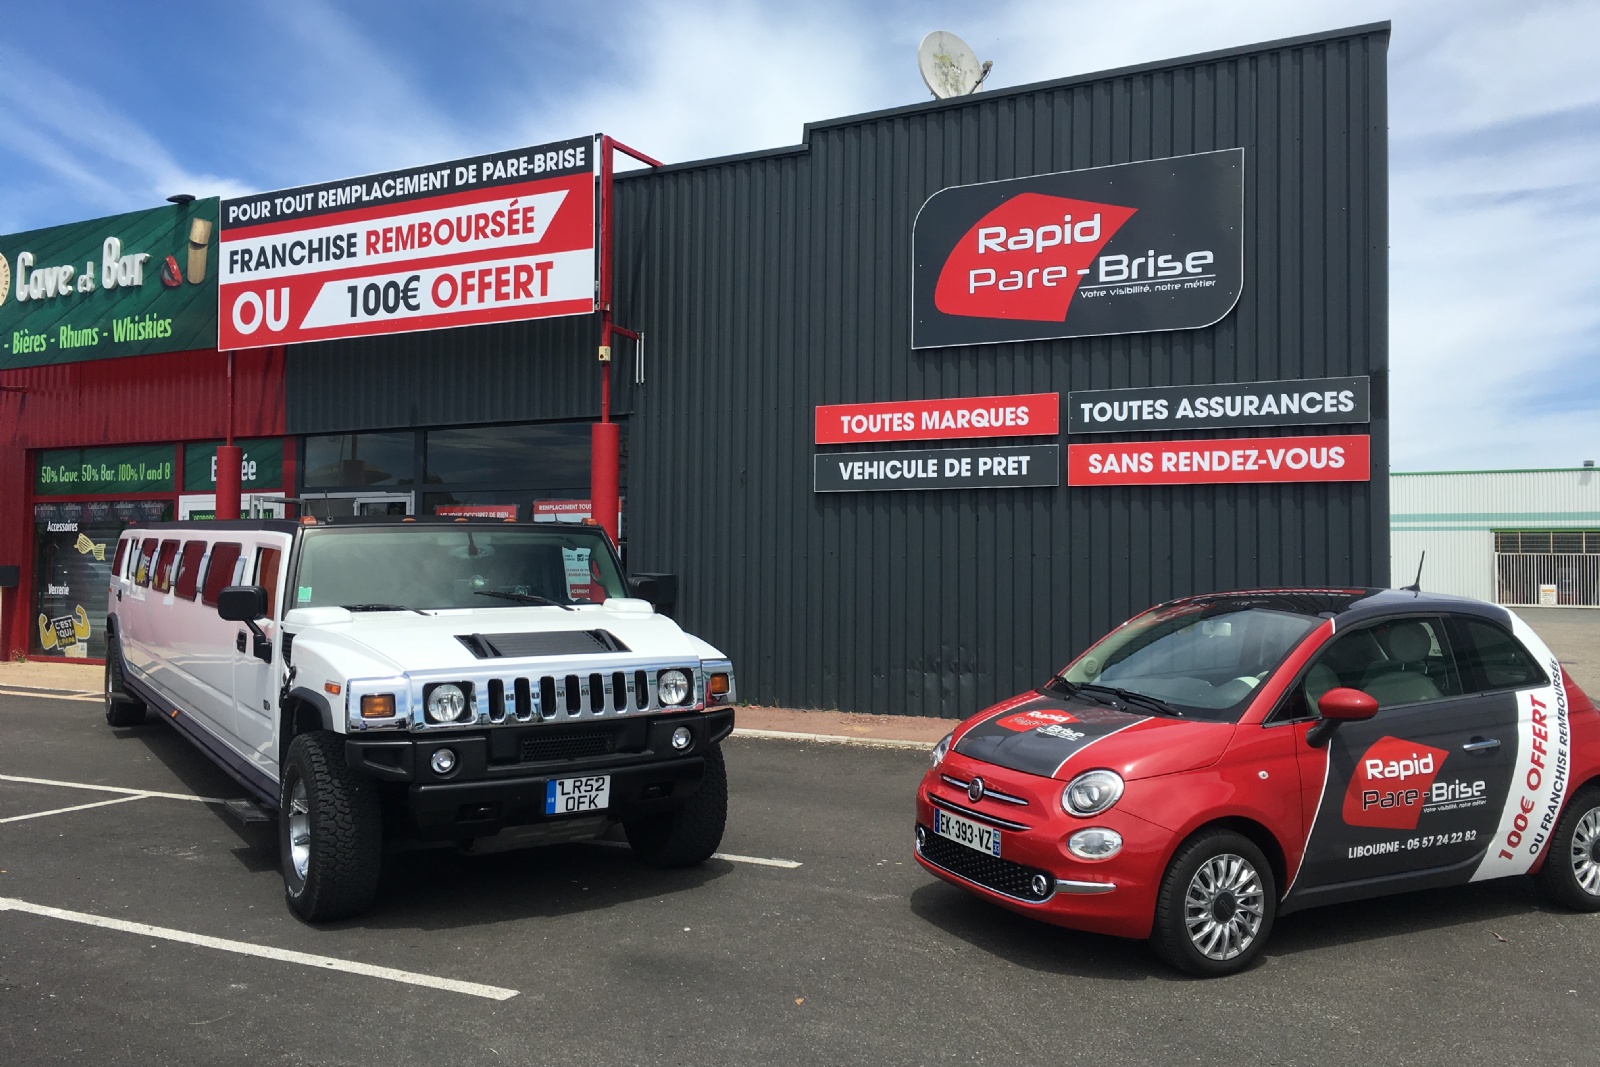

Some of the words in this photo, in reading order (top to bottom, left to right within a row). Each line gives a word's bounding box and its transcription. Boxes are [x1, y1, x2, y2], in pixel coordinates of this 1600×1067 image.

[229, 205, 271, 223] POUR
[275, 194, 313, 216] TOUT
[318, 170, 451, 208] REMPLACEMENT
[455, 163, 477, 186] DE
[482, 146, 585, 182] PARE-BRISE
[229, 233, 357, 274] FRANCHISE
[365, 199, 535, 256] REMBOURSÉE
[978, 213, 1101, 254] Rapid
[16, 251, 75, 303] Cave
[102, 236, 151, 290] Bar
[232, 287, 290, 335] OU
[347, 275, 421, 318] 100€
[431, 261, 554, 308] OFFERT
[1081, 290, 1107, 299] Votre
[1155, 281, 1181, 291] notre
[1184, 279, 1216, 290] métier
[12, 328, 47, 354] Bières
[59, 325, 99, 349] Rhums
[113, 312, 172, 343] Whiskies
[841, 413, 915, 433] TOUTES
[921, 406, 1030, 430] MARQUES
[1080, 399, 1169, 423] TOUTES
[1175, 391, 1355, 419] ASSURANCES
[41, 466, 58, 483] 50%
[81, 464, 99, 482] 50%
[118, 463, 138, 482] 100%
[139, 463, 145, 481] V
[147, 463, 163, 480] and
[211, 453, 257, 481] Eée
[839, 458, 938, 480] VEHICULE
[944, 458, 973, 477] DE
[978, 456, 1031, 476] PRET
[1088, 452, 1154, 474] SANS
[1161, 446, 1346, 472] RENDEZ-VOUS
[47, 521, 78, 532] Accessoires
[48, 581, 69, 595] Verrerie
[1550, 657, 1568, 747] REMBOURSÉE
[1365, 752, 1434, 781] Rapid
[1498, 795, 1535, 861] 100€
[1526, 694, 1548, 792] OFFERT
[558, 777, 605, 795] LR52
[1541, 747, 1567, 832] FRANCHISE
[940, 813, 992, 851] EK-393-VZ
[1348, 841, 1400, 859] LIBOURNE
[1407, 838, 1420, 850] 05
[1421, 836, 1434, 848] 57
[1436, 834, 1448, 845] 24
[1450, 832, 1463, 844] 22
[1464, 830, 1477, 842] 82
[1529, 832, 1545, 855] OU
